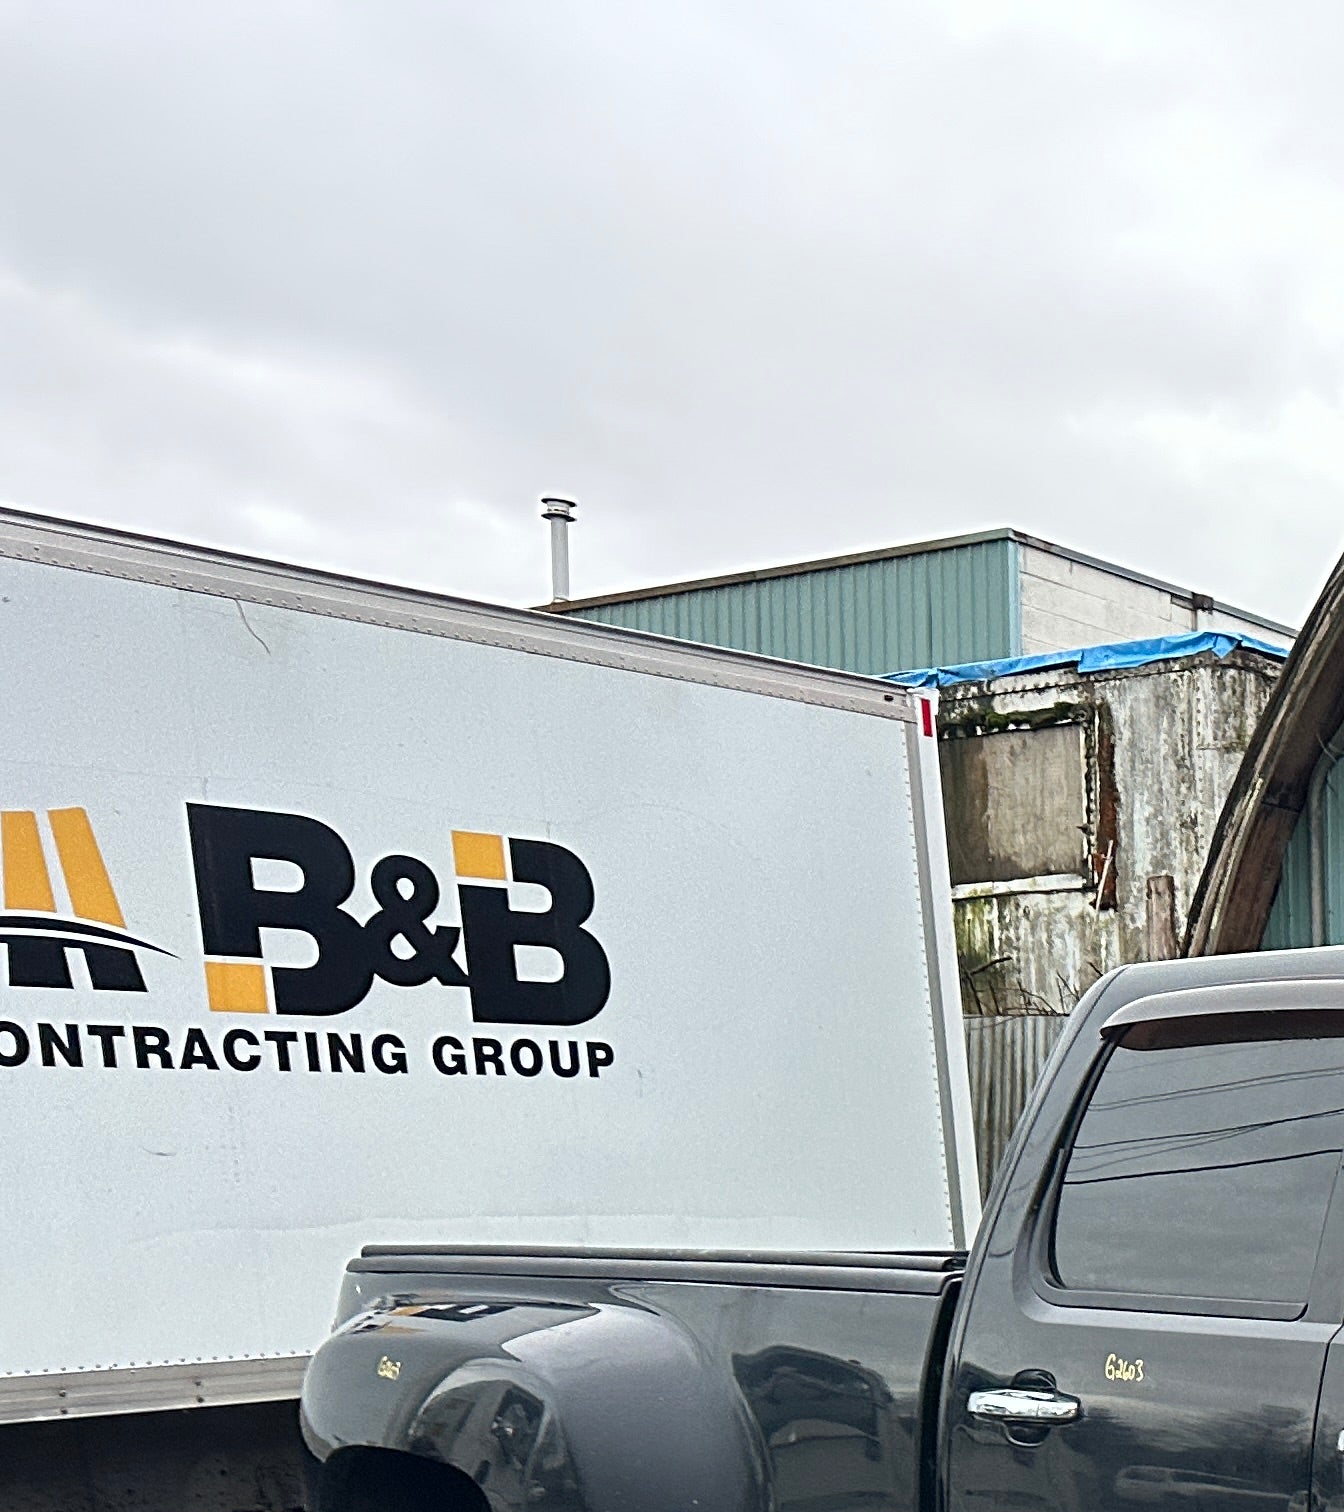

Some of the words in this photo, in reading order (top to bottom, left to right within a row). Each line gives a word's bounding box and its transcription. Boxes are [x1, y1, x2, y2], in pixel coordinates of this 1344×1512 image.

[185, 801, 611, 1026] B&B
[432, 1035, 615, 1078] GROUP
[1105, 1353, 1144, 1382] G2603
